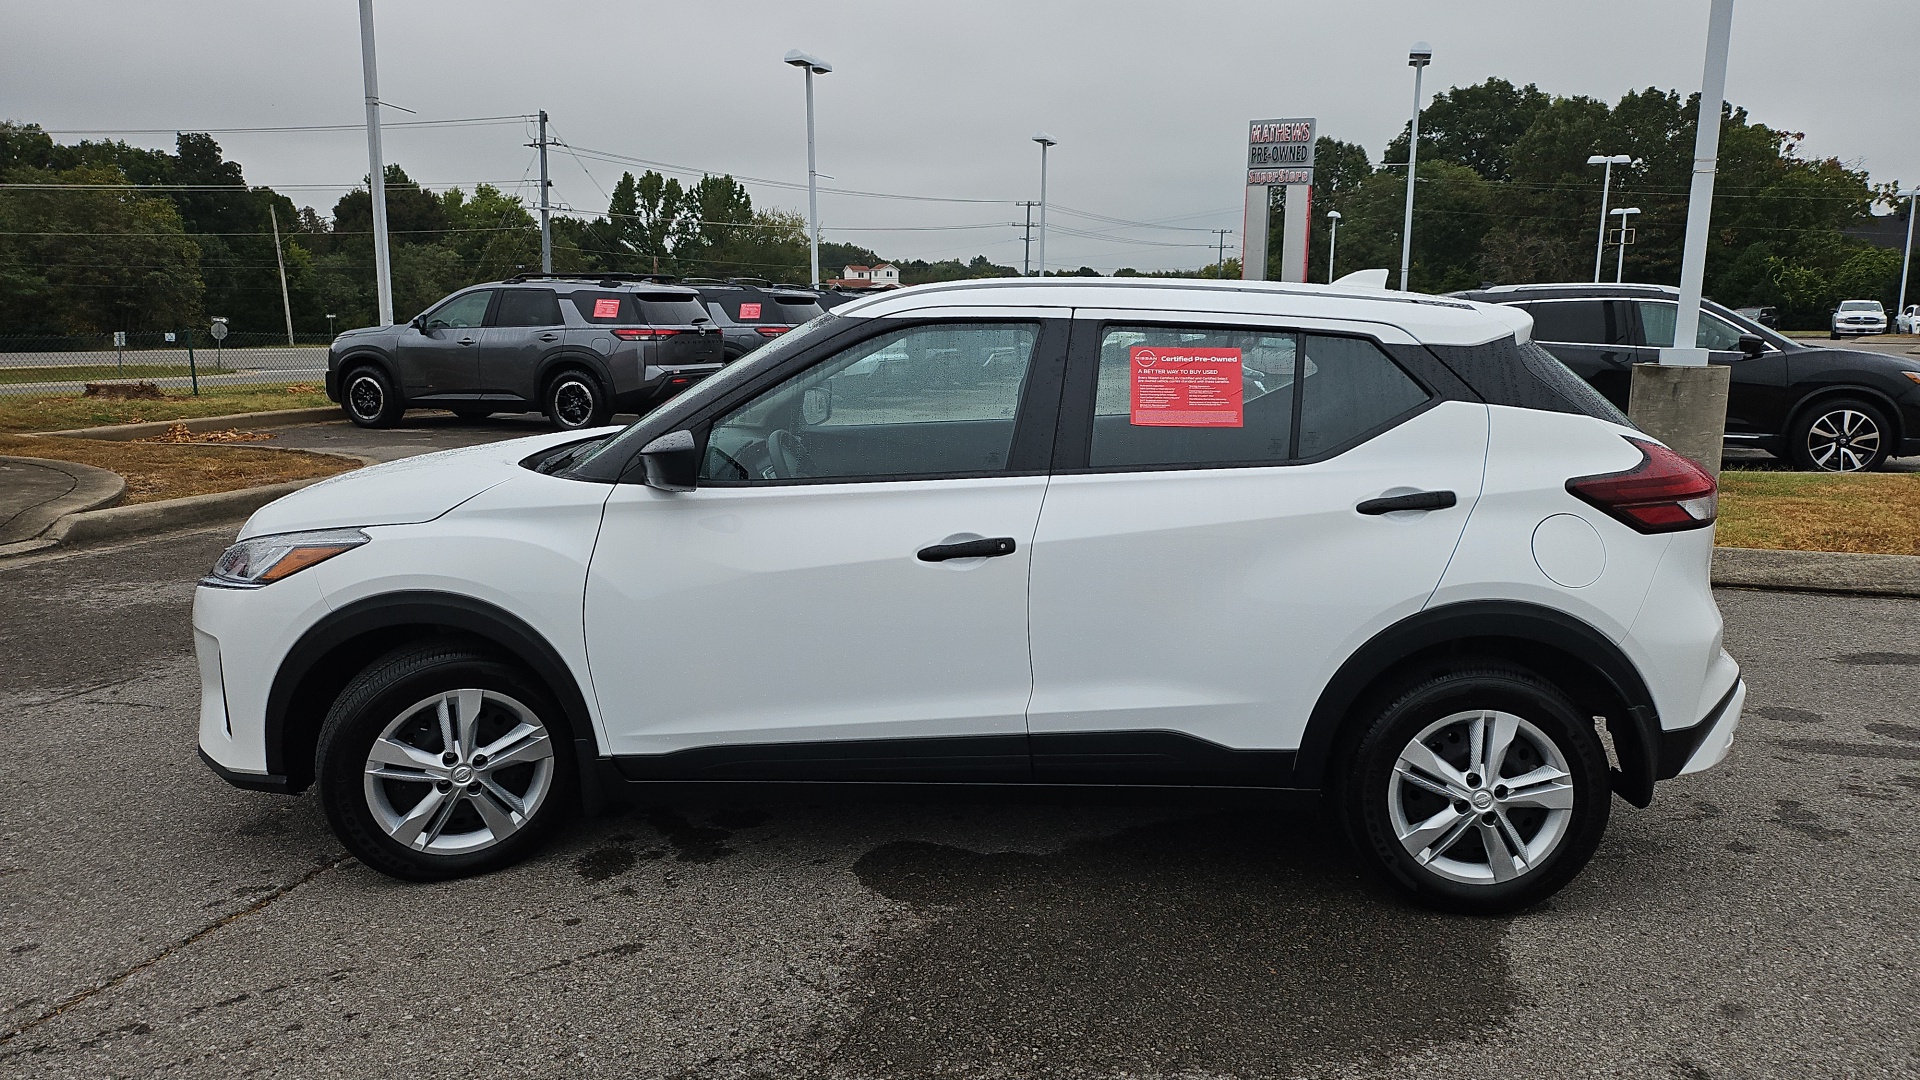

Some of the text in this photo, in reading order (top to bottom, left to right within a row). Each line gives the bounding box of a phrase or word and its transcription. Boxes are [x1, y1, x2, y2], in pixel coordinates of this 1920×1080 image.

[1251, 123, 1310, 143] MATHEWS
[1251, 145, 1309, 163] PRE-OWNED
[1248, 169, 1308, 184] SuperStore
